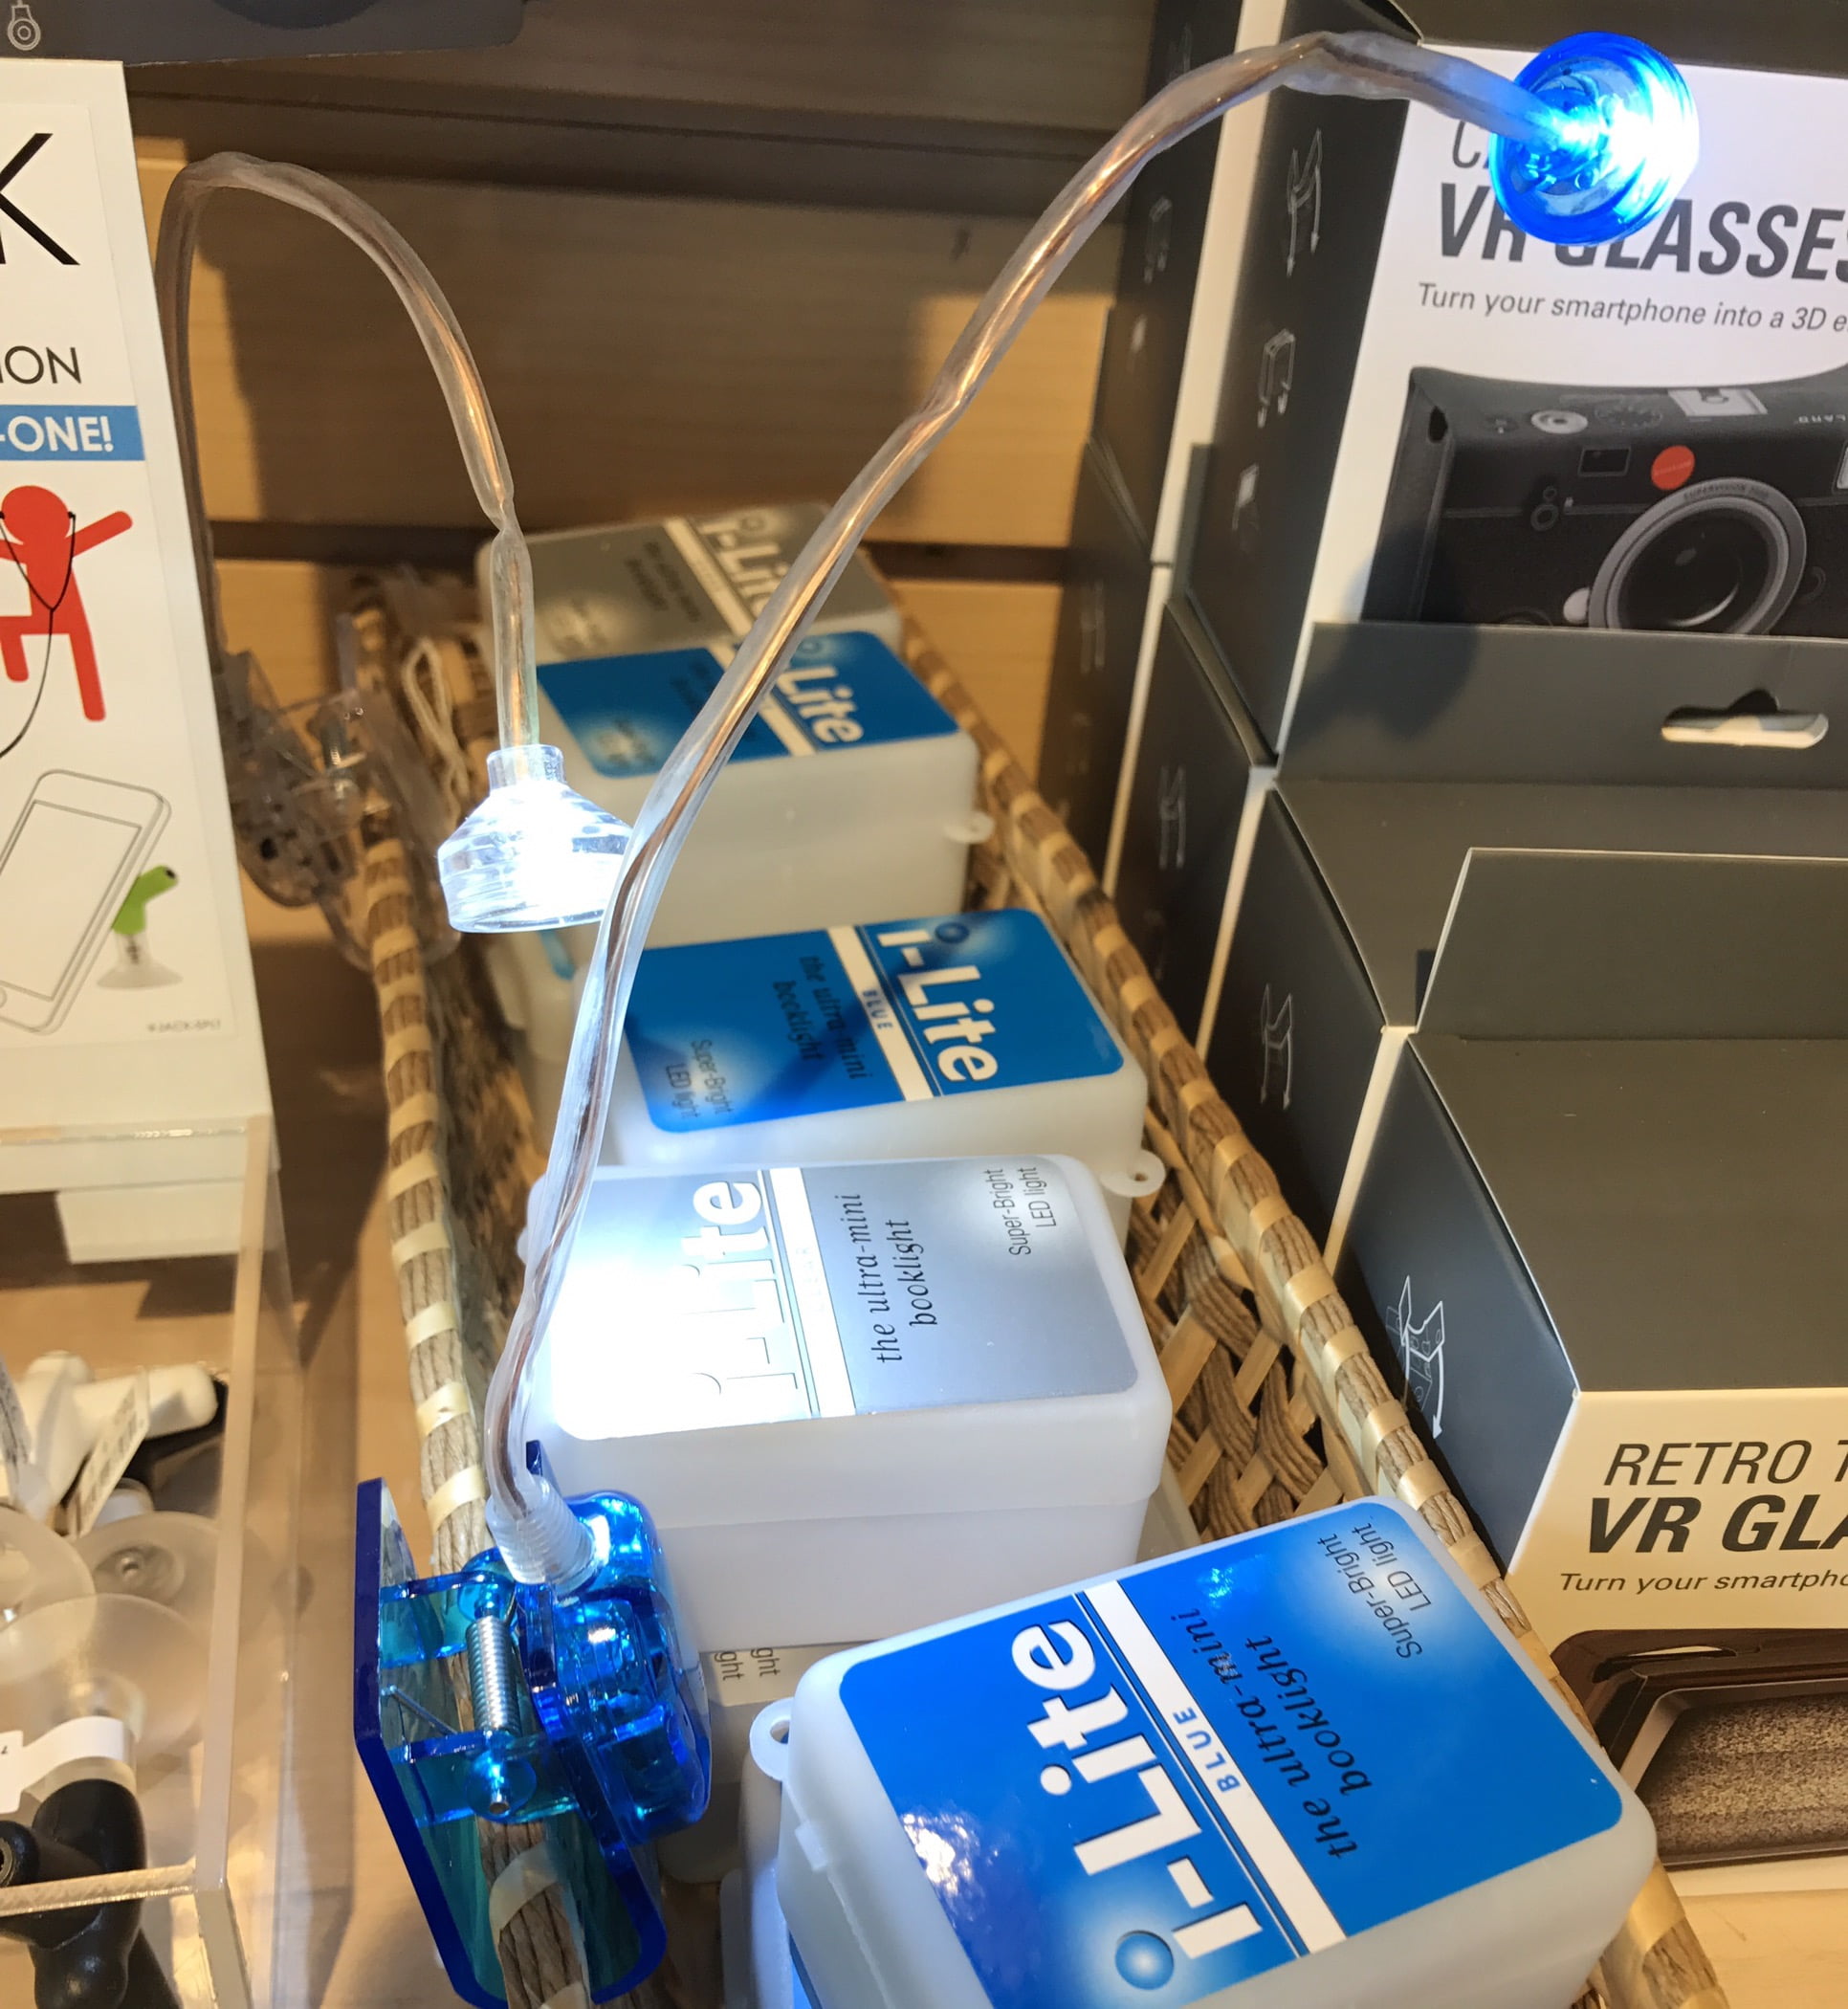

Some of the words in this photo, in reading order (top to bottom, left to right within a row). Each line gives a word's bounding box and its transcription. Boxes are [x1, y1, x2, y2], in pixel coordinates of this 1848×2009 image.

[1555, 198, 1848, 284] ASSE
[1419, 282, 1475, 309] Turn
[1484, 294, 1545, 317] your
[1551, 298, 1706, 326] smartphone
[1714, 300, 1762, 327] into
[1770, 310, 1784, 329] a
[1791, 307, 1826, 331] 3D
[0, 345, 82, 385] ON
[800, 955, 826, 982] the
[813, 987, 872, 1079] ultra-mini
[863, 989, 893, 1029] BLUE
[877, 922, 999, 1083] i-Lite
[1017, 1167, 1047, 1196] light
[984, 1168, 1031, 1256] Super-Bright
[1029, 1200, 1057, 1228] LED
[835, 1194, 891, 1314] ultra-mini
[886, 1220, 937, 1327] booklight
[871, 1323, 902, 1362] the
[1604, 1440, 1812, 1486] RETRO
[1351, 1522, 1396, 1566] light
[1589, 1496, 1702, 1553] VR
[1317, 1533, 1422, 1660] Super-Bright
[1387, 1570, 1431, 1612] LED
[1560, 1573, 1626, 1591] Turn
[1636, 1578, 1707, 1595] your
[1170, 1608, 1311, 1788] ultra-mini
[1246, 1635, 1373, 1796] booklight
[1173, 1707, 1241, 1792] BLUE
[1012, 1619, 1264, 1990] i-Lite
[1303, 1798, 1358, 1858] the
